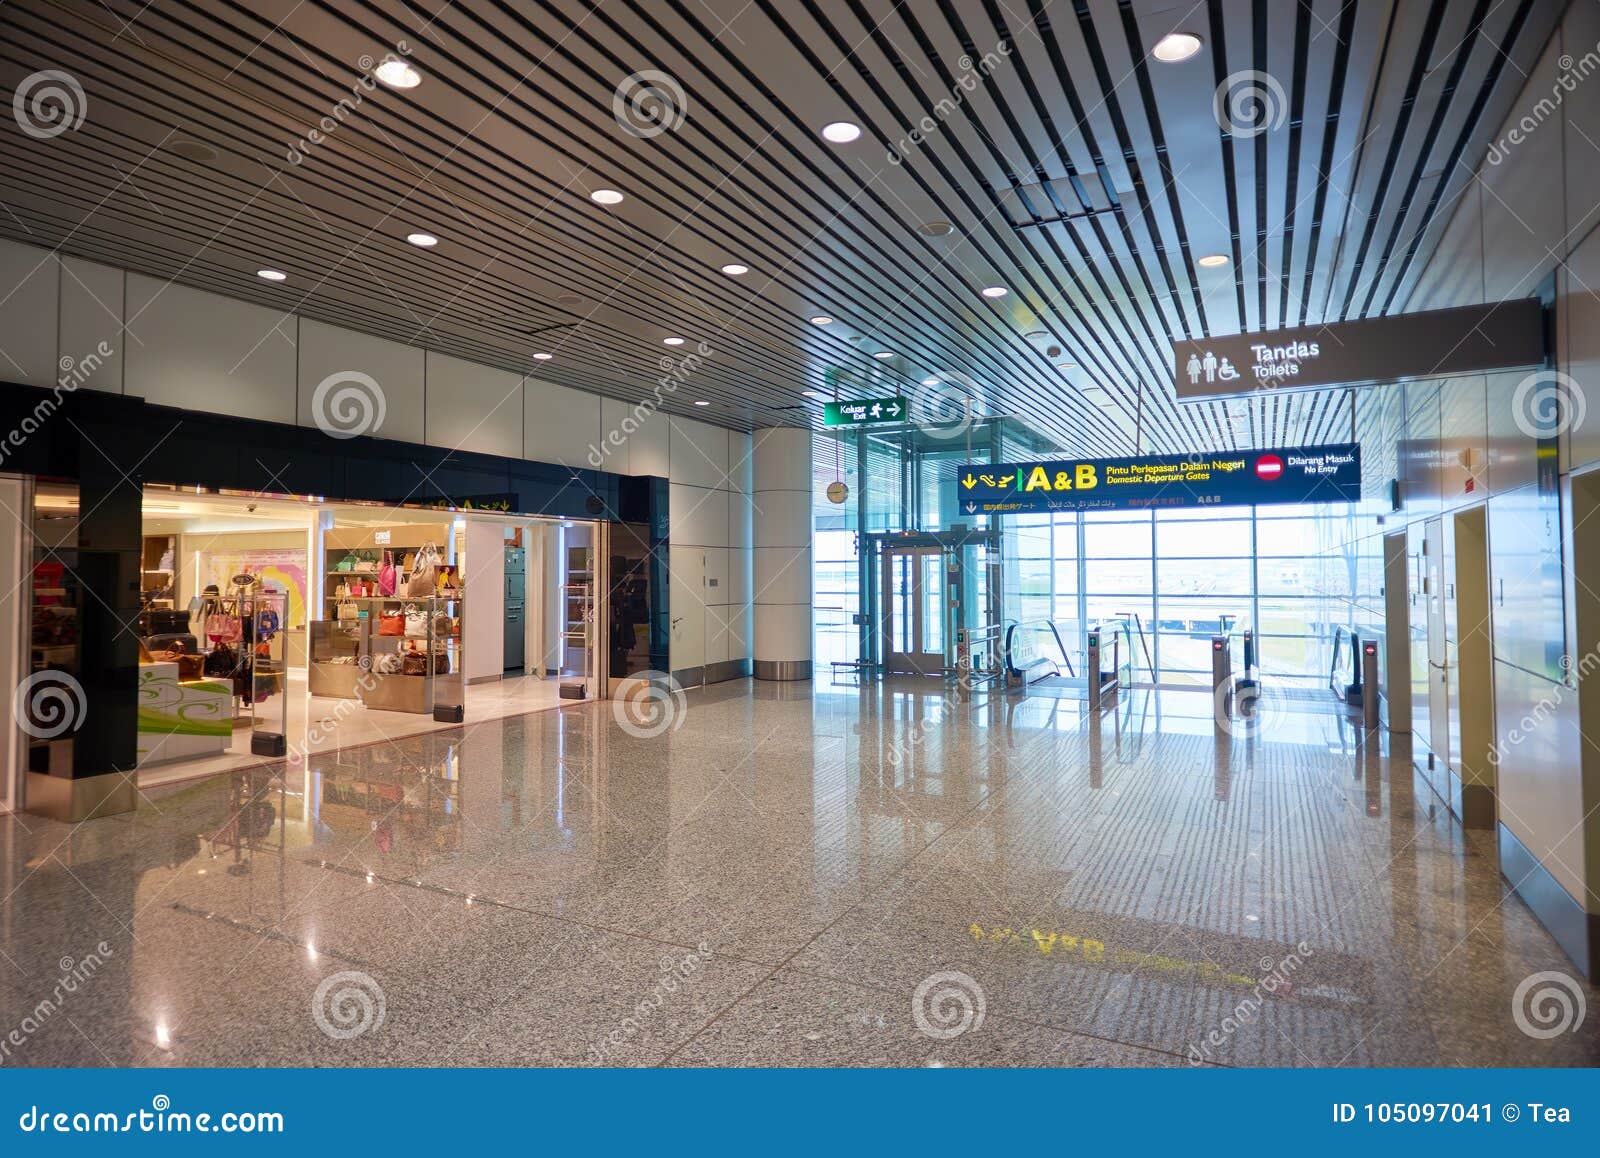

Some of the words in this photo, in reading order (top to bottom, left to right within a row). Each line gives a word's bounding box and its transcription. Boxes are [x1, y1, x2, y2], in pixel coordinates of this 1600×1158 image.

[1250, 339, 1320, 361] Tandas
[1251, 362, 1299, 378] Toilets
[840, 404, 866, 414] Keluar
[853, 412, 866, 420] Exit
[1287, 456, 1324, 466] Dilarang
[1325, 452, 1354, 463] Masuk
[1106, 466, 1129, 475] Pintu
[1131, 463, 1178, 475] Perlepasan
[1180, 461, 1210, 472] Dalam
[1212, 459, 1245, 472] Negeri
[1304, 466, 1316, 474] No
[1318, 465, 1338, 474] Entry
[1107, 475, 1142, 484] Domestic
[1144, 473, 1184, 484] Departure
[1186, 471, 1210, 480] Gates
